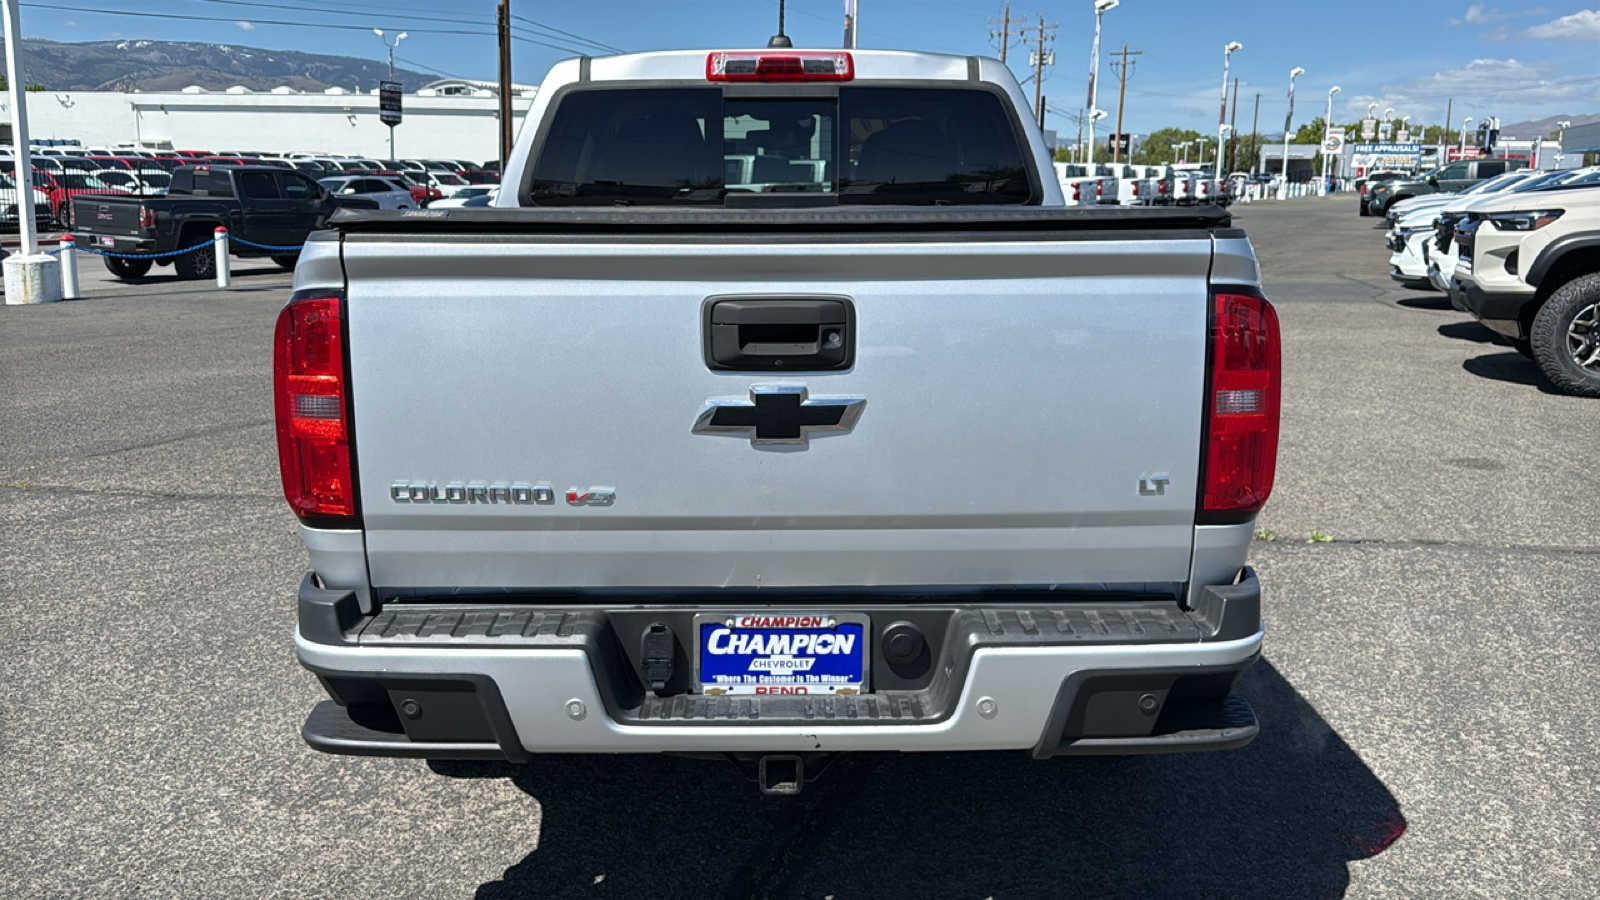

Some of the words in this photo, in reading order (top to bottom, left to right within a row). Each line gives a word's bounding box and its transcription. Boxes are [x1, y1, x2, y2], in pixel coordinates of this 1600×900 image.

[1355, 144, 1374, 152] FREE
[1138, 475, 1170, 497] LT
[390, 483, 555, 504] COLORADO
[740, 616, 823, 628] CHAMPION
[707, 628, 856, 655] CHAMPION
[753, 660, 810, 669] CHEVROLET
[743, 674, 757, 683] The
[759, 674, 795, 683] Customer
[805, 674, 819, 683] The
